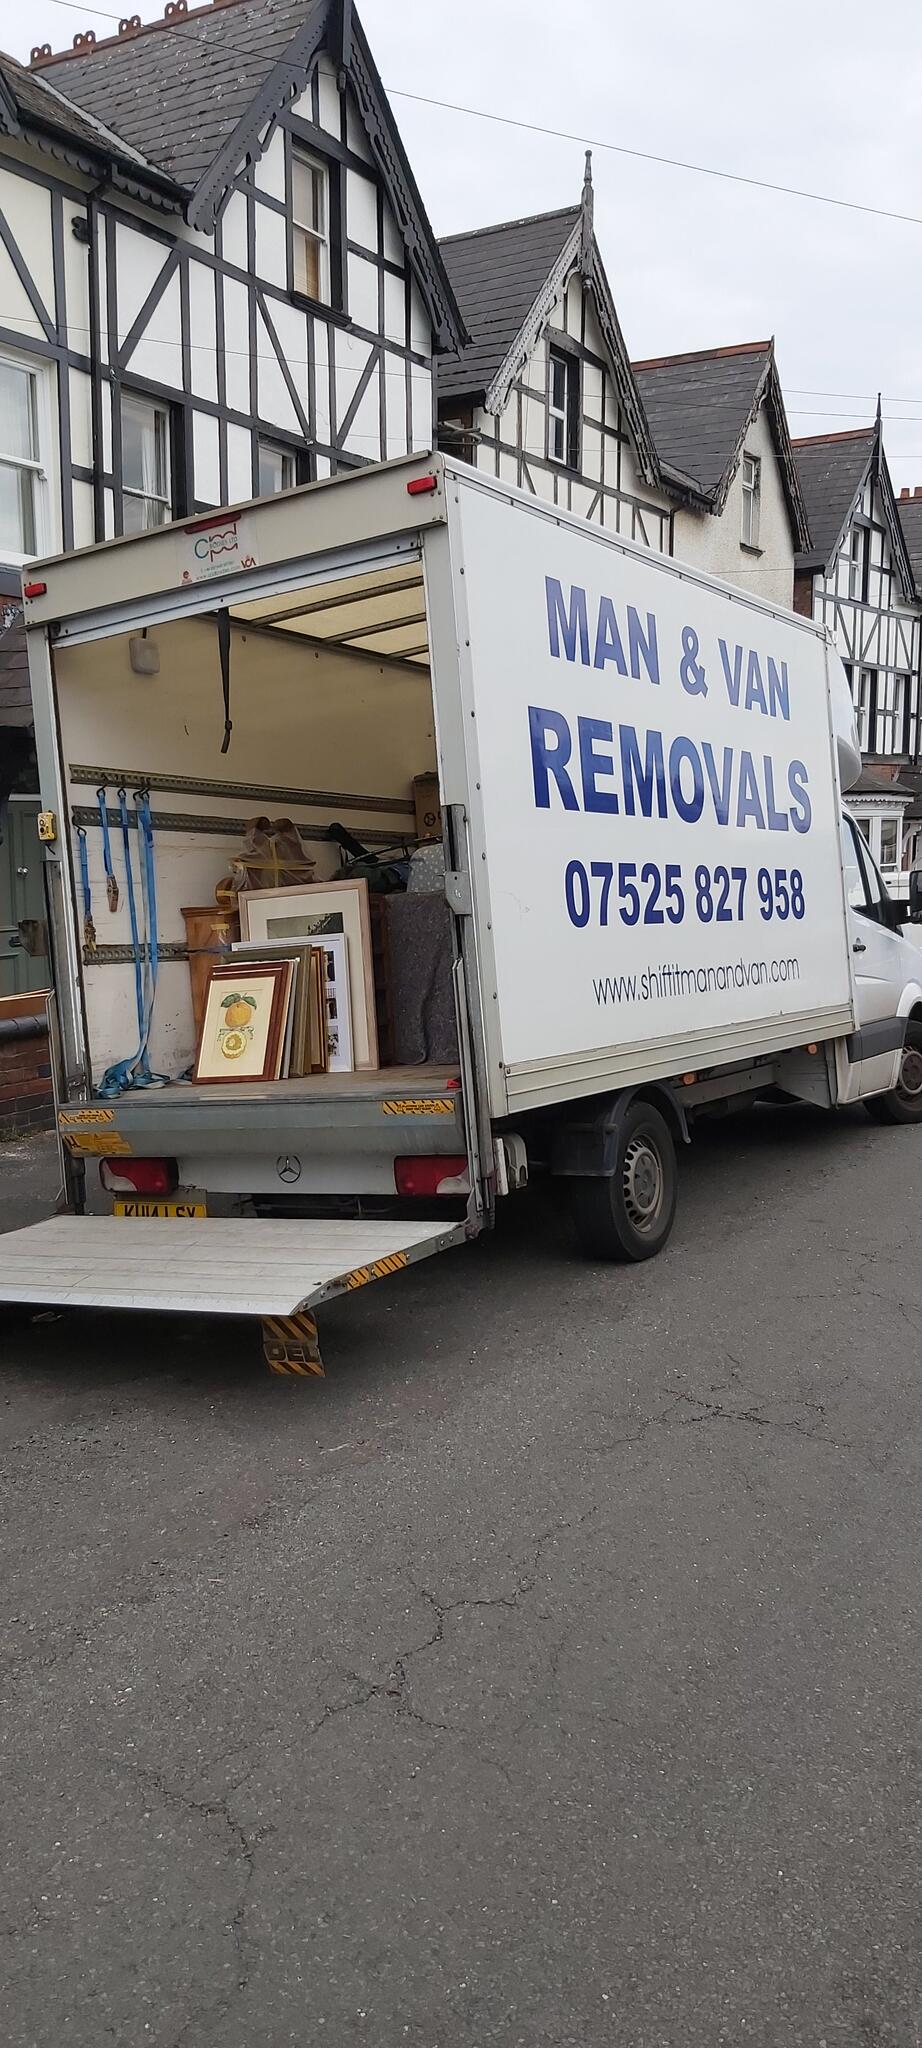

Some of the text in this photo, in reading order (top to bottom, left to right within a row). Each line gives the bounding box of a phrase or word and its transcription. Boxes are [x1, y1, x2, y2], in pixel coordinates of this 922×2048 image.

[544, 575, 791, 721] MAN & VAN
[527, 705, 812, 834] REMOVALS
[565, 859, 806, 928] 07525 827 958
[592, 957, 801, 1006] www.shiftitmanandvan.com
